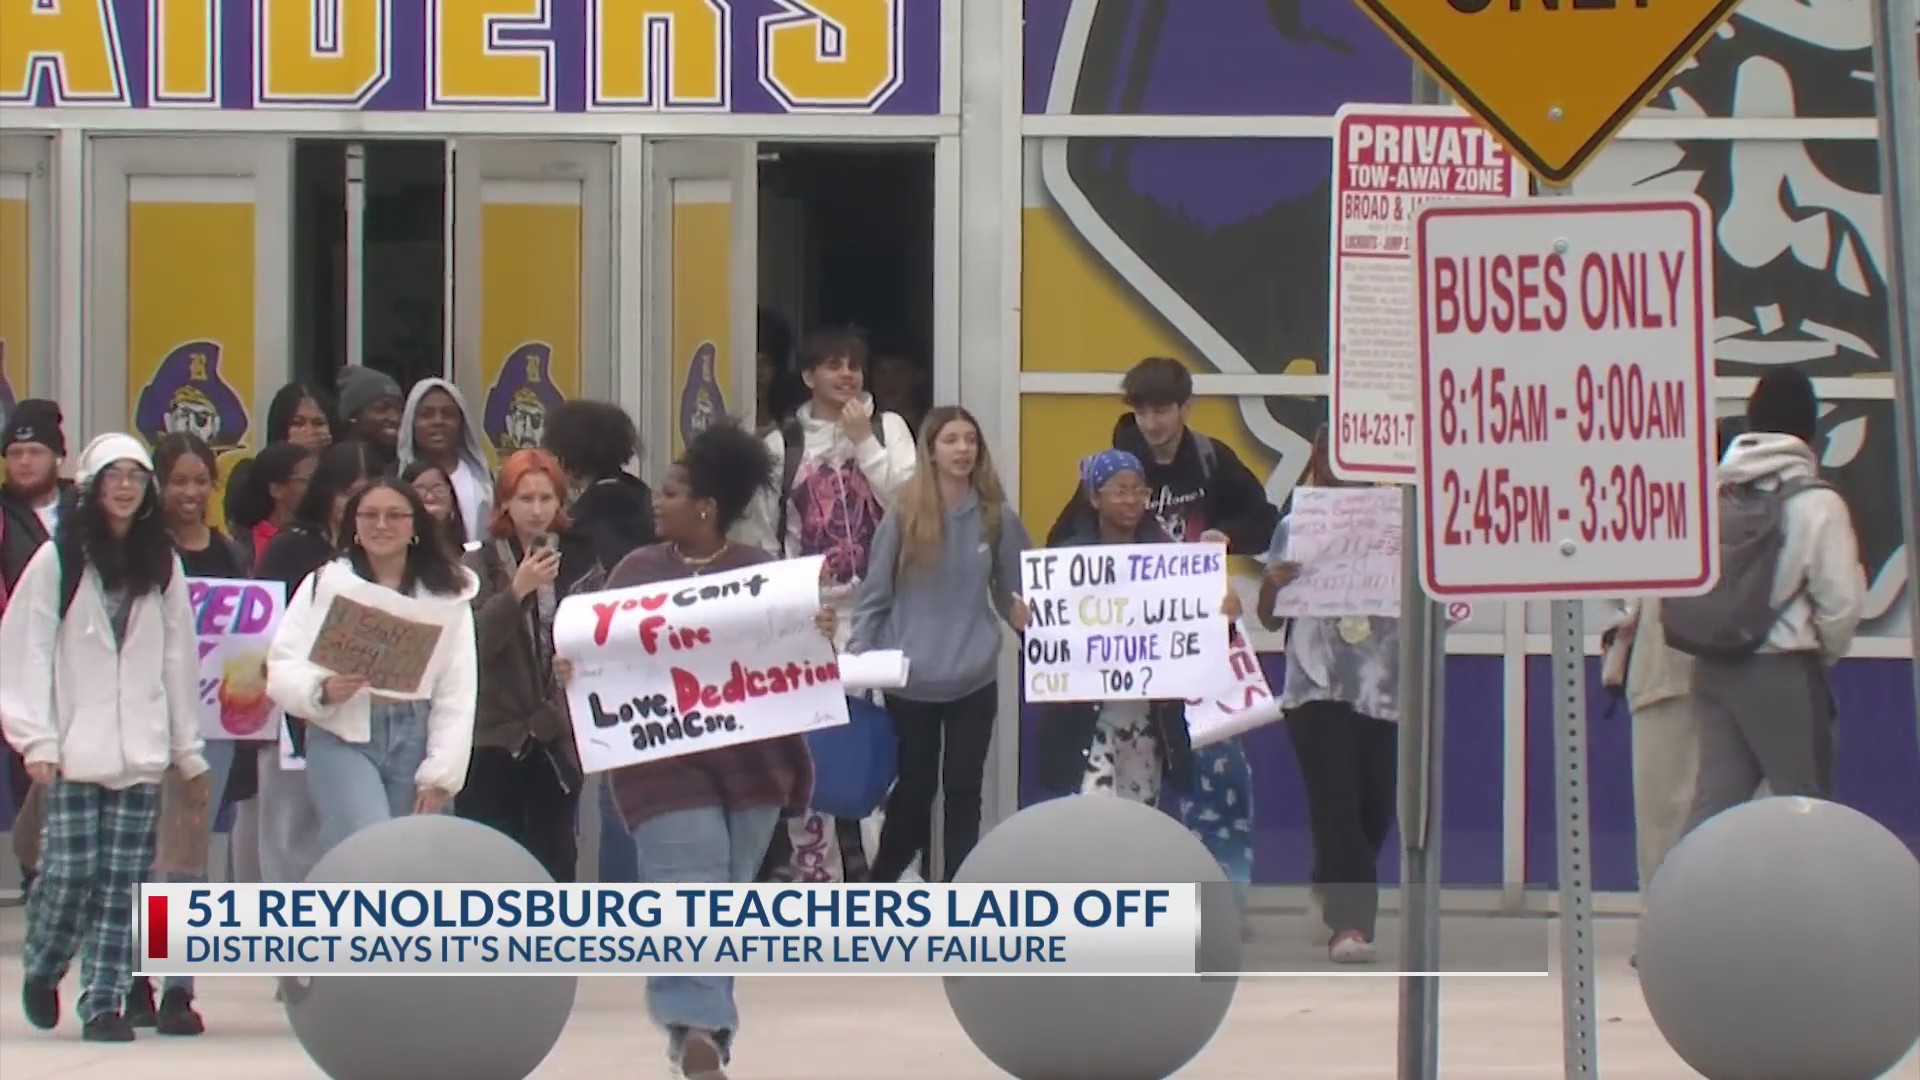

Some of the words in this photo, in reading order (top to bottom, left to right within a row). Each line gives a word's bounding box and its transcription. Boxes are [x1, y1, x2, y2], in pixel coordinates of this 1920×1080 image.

[1348, 123, 1505, 167] PRIVATE
[1347, 164, 1450, 190] TOW-AWAY
[1454, 167, 1504, 192] ZONE
[1344, 194, 1390, 221] BROAD
[1393, 195, 1404, 222] &
[1433, 253, 1568, 334] BUSES
[1579, 250, 1685, 331] ONLY
[1439, 366, 1548, 446] 8:15AM
[1575, 363, 1686, 442] 9:00AM
[1443, 468, 1551, 547] 2:45PM
[1579, 464, 1688, 544] 3:30PM
[1025, 554, 1058, 590] IF
[1069, 552, 1117, 588] OUR
[1127, 552, 1221, 582] TEACHERS
[1027, 597, 1072, 628] ARE
[1078, 595, 1135, 627] CUT,
[1143, 597, 1210, 626] WILL
[1027, 637, 1071, 665] OUR
[1086, 633, 1162, 664] FUTURE
[1170, 630, 1201, 660] BE
